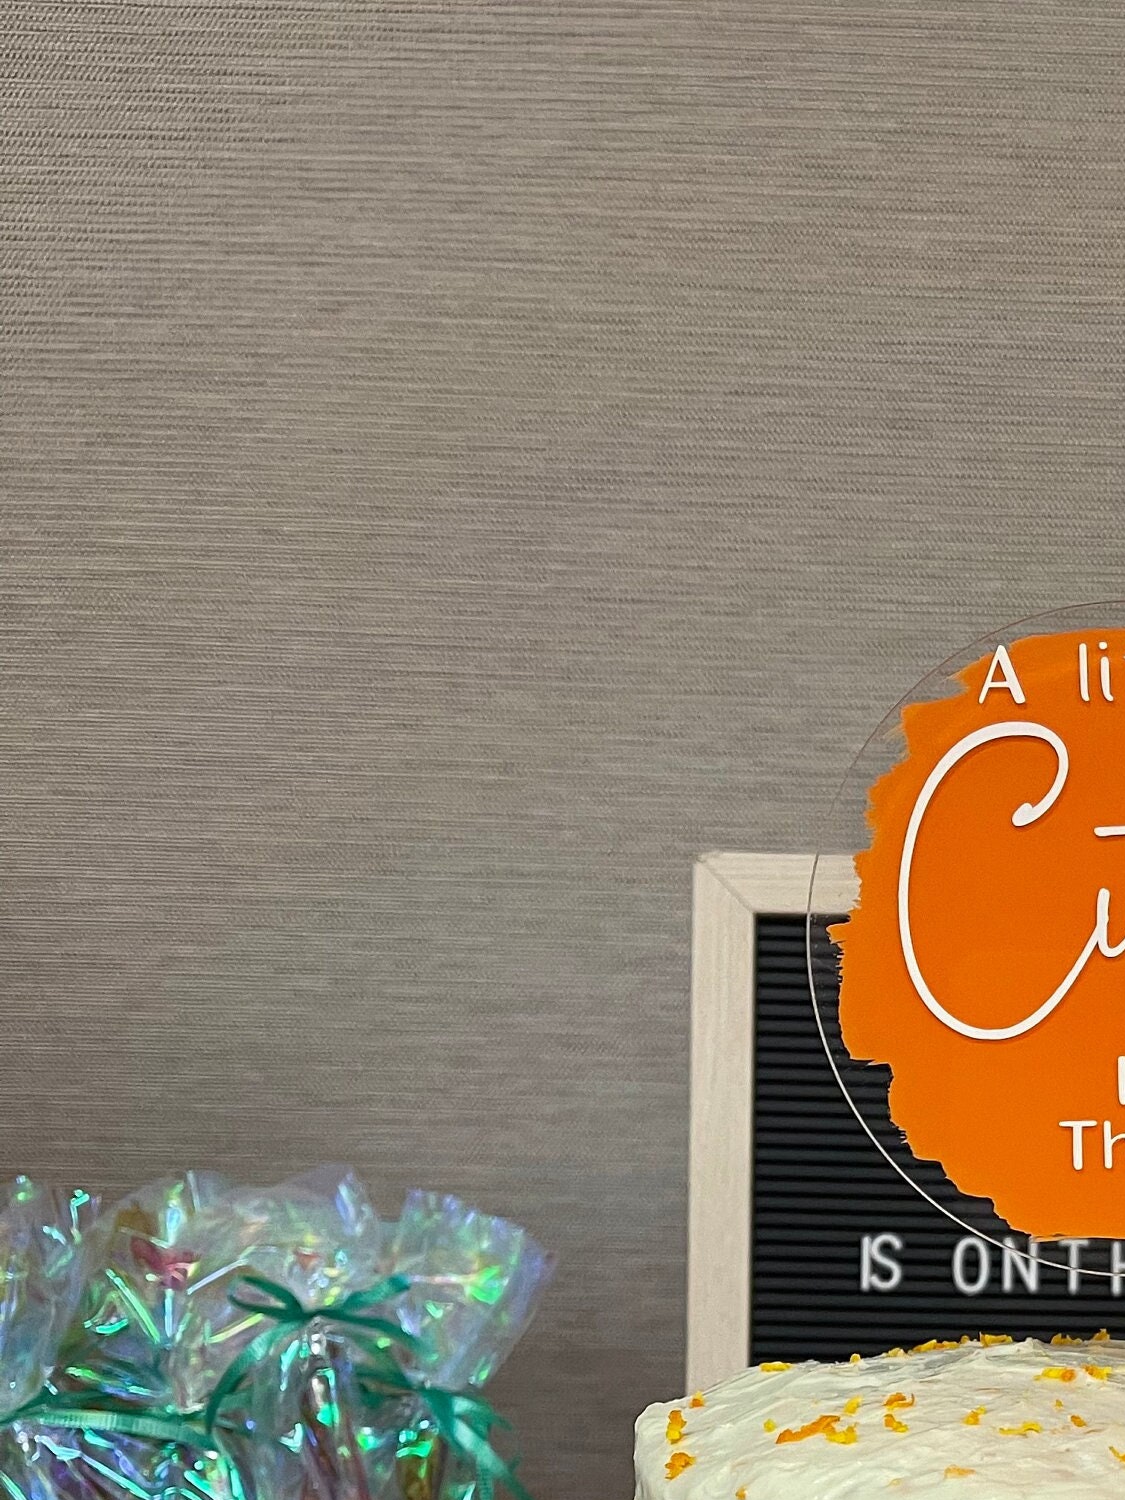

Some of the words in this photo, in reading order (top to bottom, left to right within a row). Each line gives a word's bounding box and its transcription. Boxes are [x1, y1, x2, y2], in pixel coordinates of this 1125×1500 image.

[979, 645, 1025, 704] A
[859, 1232, 904, 1292] IS
[952, 1236, 1040, 1295] ON
